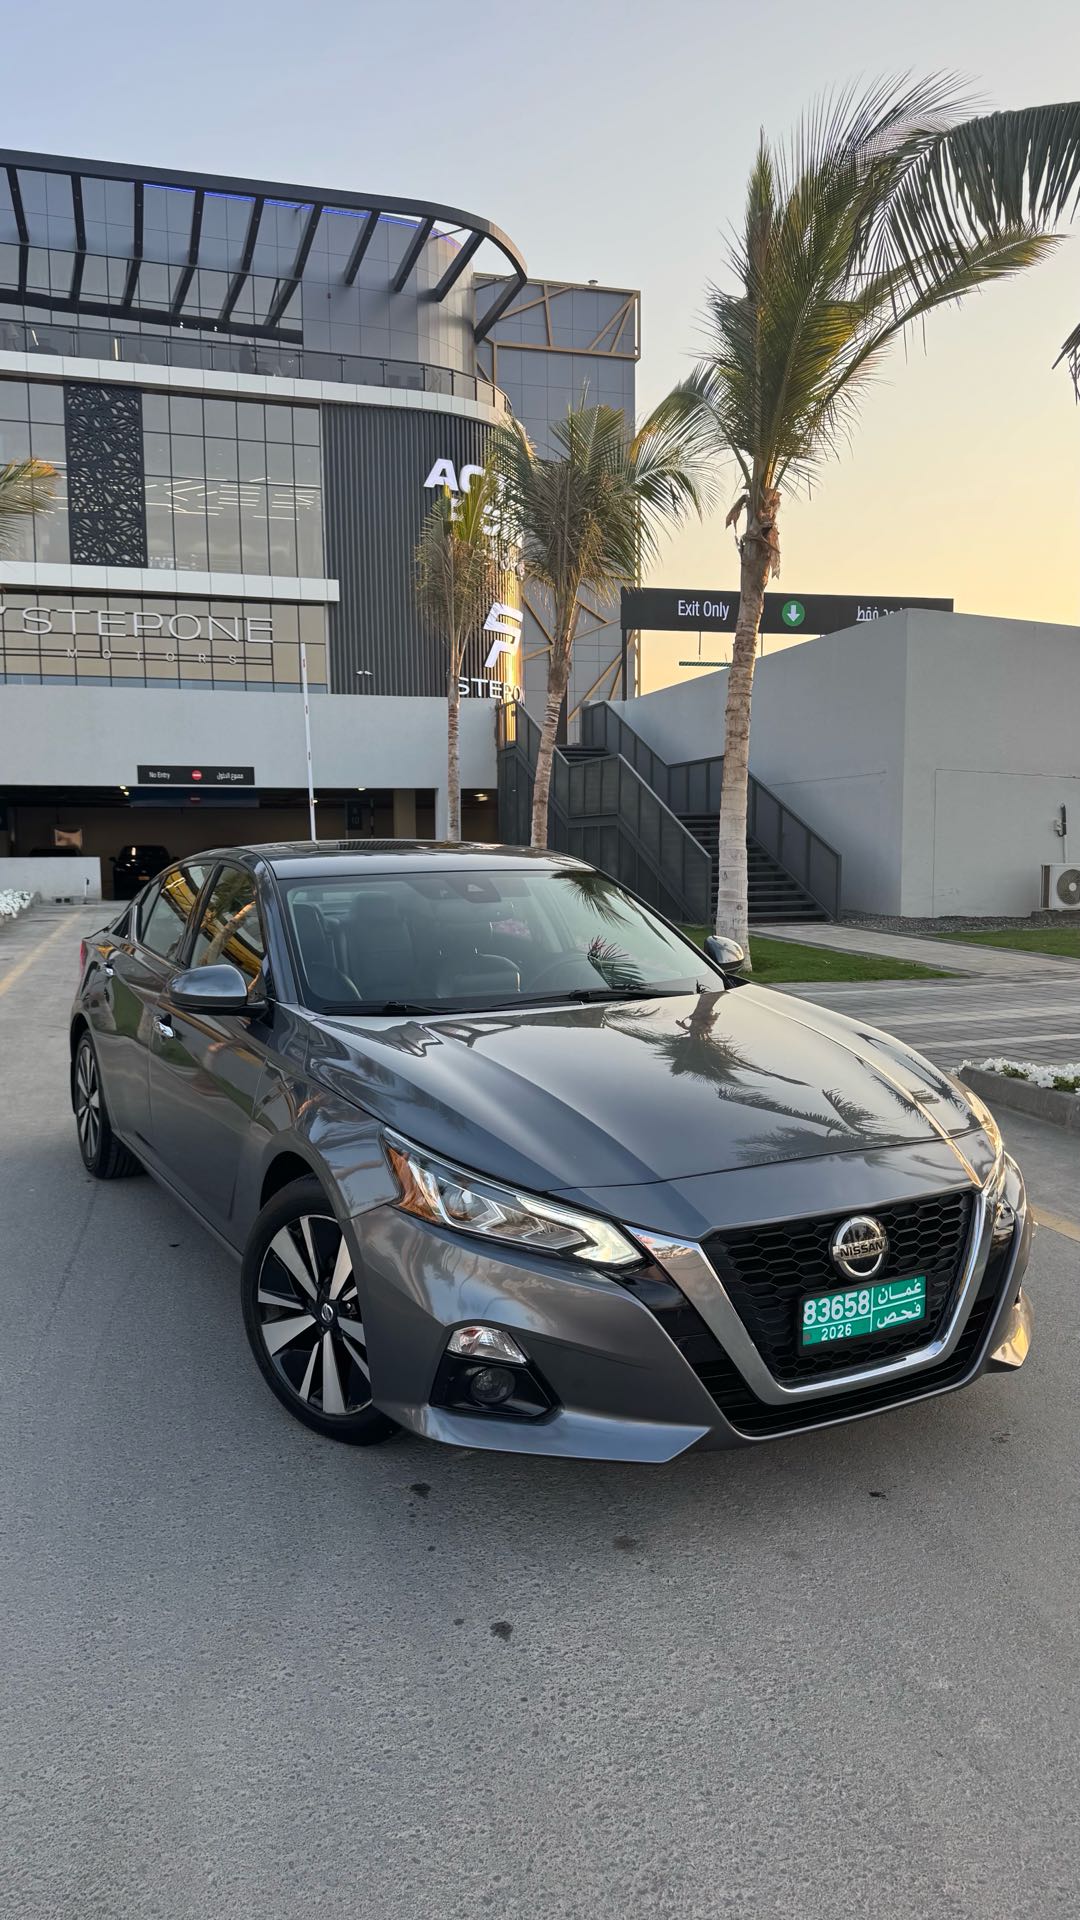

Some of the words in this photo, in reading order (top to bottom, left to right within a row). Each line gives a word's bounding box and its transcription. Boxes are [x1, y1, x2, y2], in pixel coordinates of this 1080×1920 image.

[678, 600, 700, 617] Exit
[703, 600, 730, 621] Only
[23, 607, 274, 643] STEPONE
[67, 648, 237, 665] MOTORS
[157, 771, 171, 780] Entry
[840, 1241, 884, 1258] NISSAN
[803, 1289, 870, 1325] 83658
[876, 1301, 922, 1329] فحص
[821, 1323, 852, 1342] 2026
